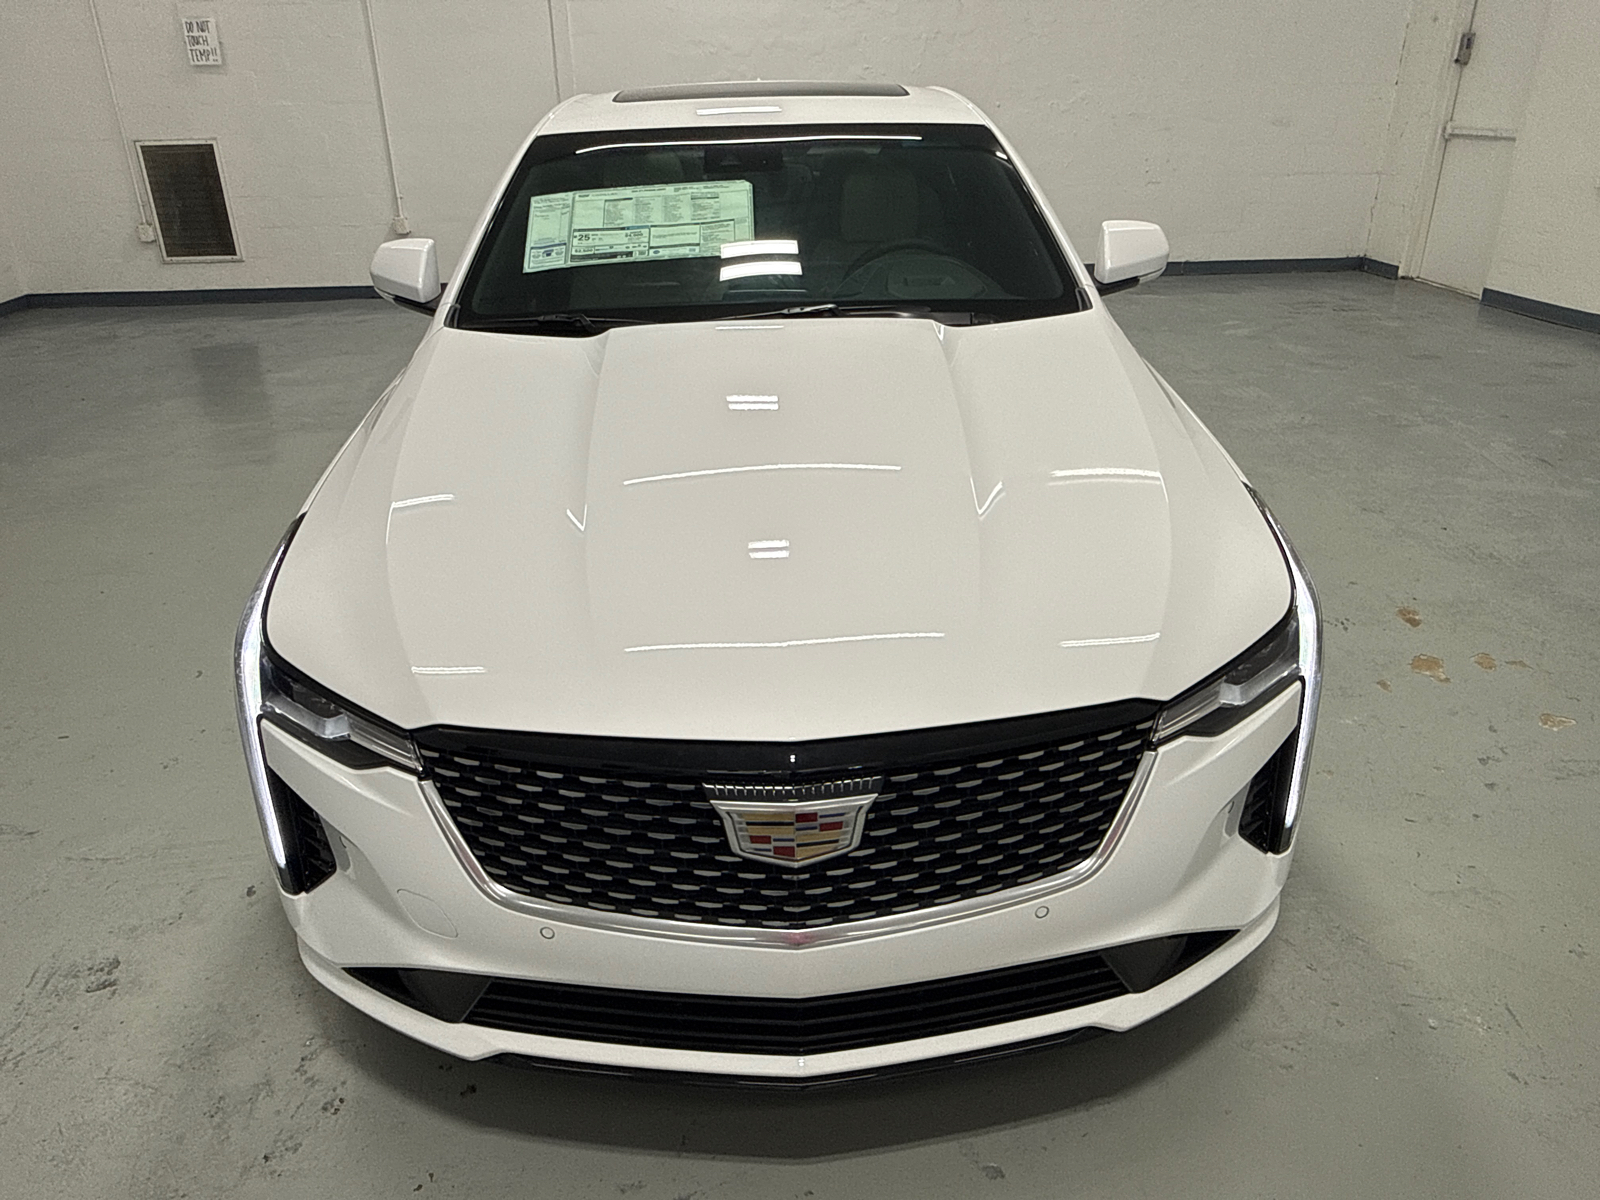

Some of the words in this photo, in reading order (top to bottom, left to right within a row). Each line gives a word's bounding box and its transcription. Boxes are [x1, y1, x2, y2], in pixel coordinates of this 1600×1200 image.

[185, 21, 194, 33] DO
[196, 20, 210, 33] NOT
[186, 35, 209, 47] TOUCH
[189, 47, 218, 62] TEMP!!
[577, 234, 590, 242] 25
